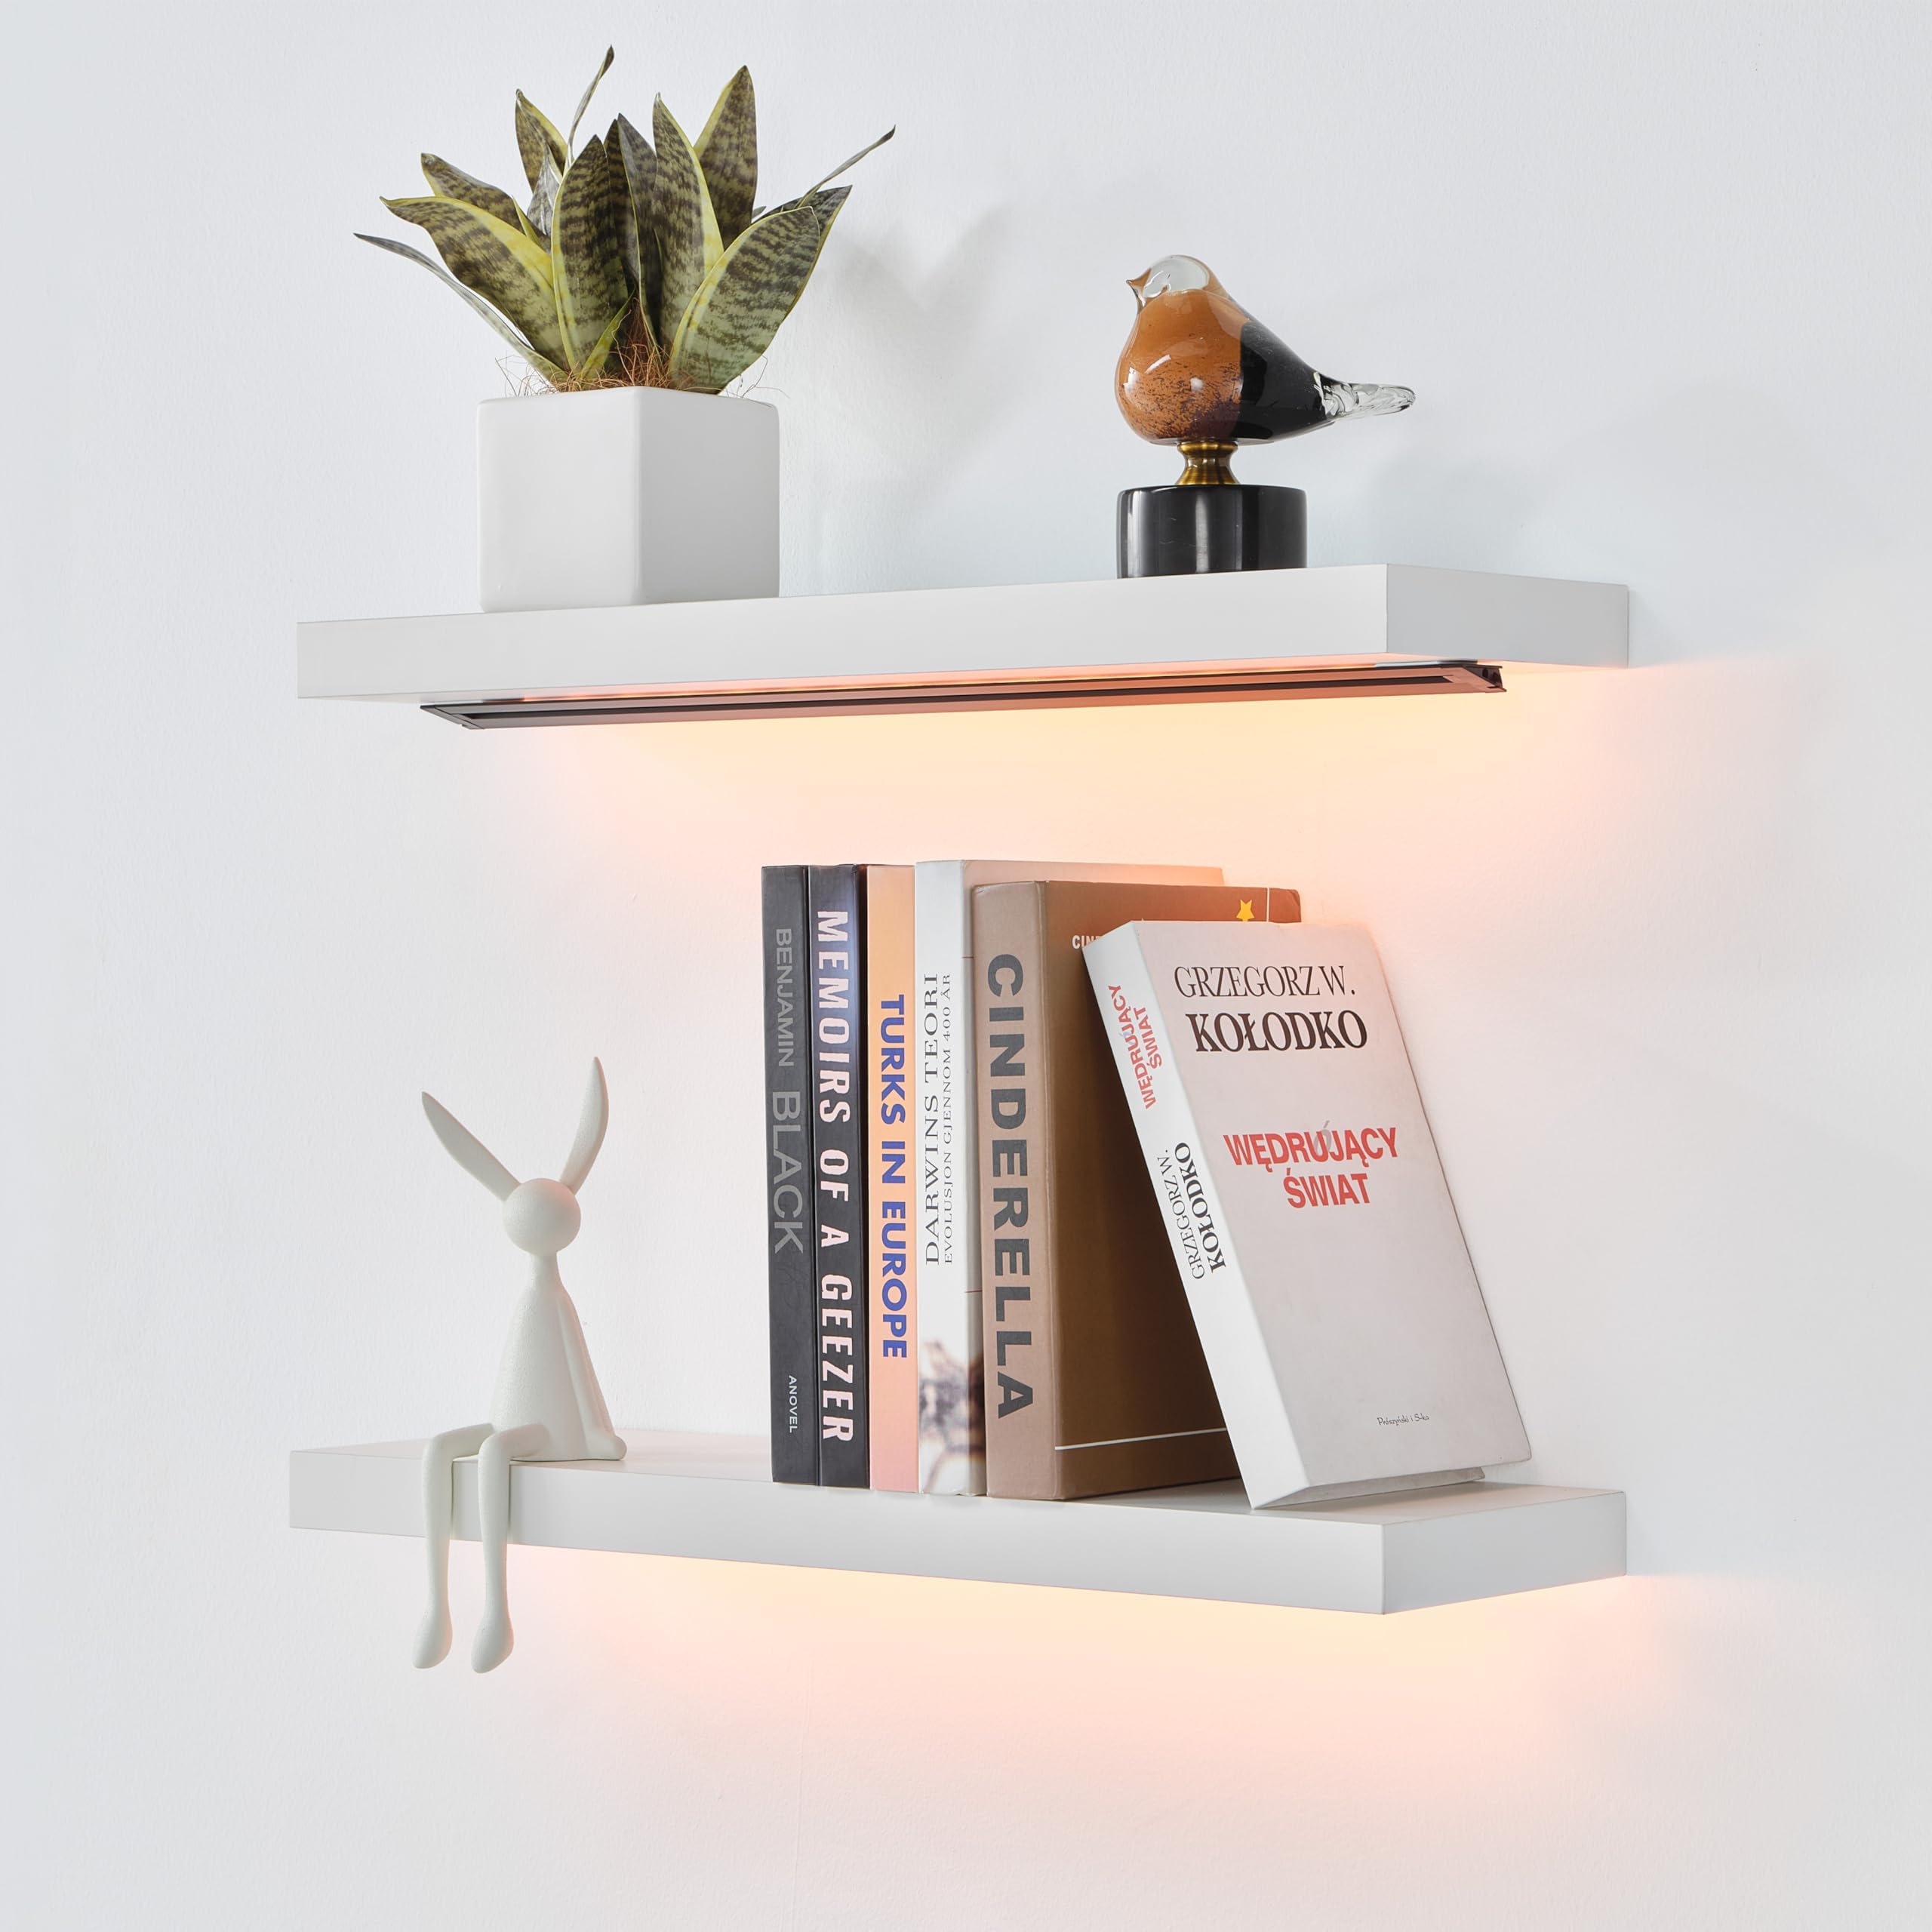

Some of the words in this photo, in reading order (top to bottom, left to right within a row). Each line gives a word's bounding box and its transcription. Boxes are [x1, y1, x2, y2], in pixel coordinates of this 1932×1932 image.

[776, 928, 795, 1068] BENJAMIN
[817, 911, 851, 1123] MEMOIRS
[924, 973, 939, 1084] TEORI
[940, 973, 951, 1001] ÅR
[943, 1007, 952, 1041] 400
[1174, 965, 1321, 998] GRZEGORZ
[1318, 965, 1356, 996] W.
[1185, 1010, 1368, 1053] KOŁODKO
[880, 994, 906, 1124] TURKS
[1108, 985, 1157, 1110] WĘDRUJĄCY
[1134, 1007, 1163, 1069] ŚWIAT
[943, 1049, 953, 1145] GJENNOM
[772, 1091, 804, 1254] BLACK
[820, 1149, 850, 1202] OF
[881, 1141, 906, 1184] IN
[924, 1095, 940, 1266] DARWINS
[987, 954, 1034, 1420] CINDERELLA
[1157, 1149, 1174, 1176] W.
[1222, 1127, 1398, 1173] WĘDRUJĄCY
[1283, 1168, 1371, 1208] ŚWIAT
[820, 1224, 850, 1247] A
[943, 1152, 953, 1265] EVOLUSJON
[1164, 1174, 1205, 1279] GRZEGORZ
[1174, 1142, 1226, 1274] KOŁODKO
[881, 1201, 908, 1358] EUROPE
[821, 1274, 854, 1441] GEEZER
